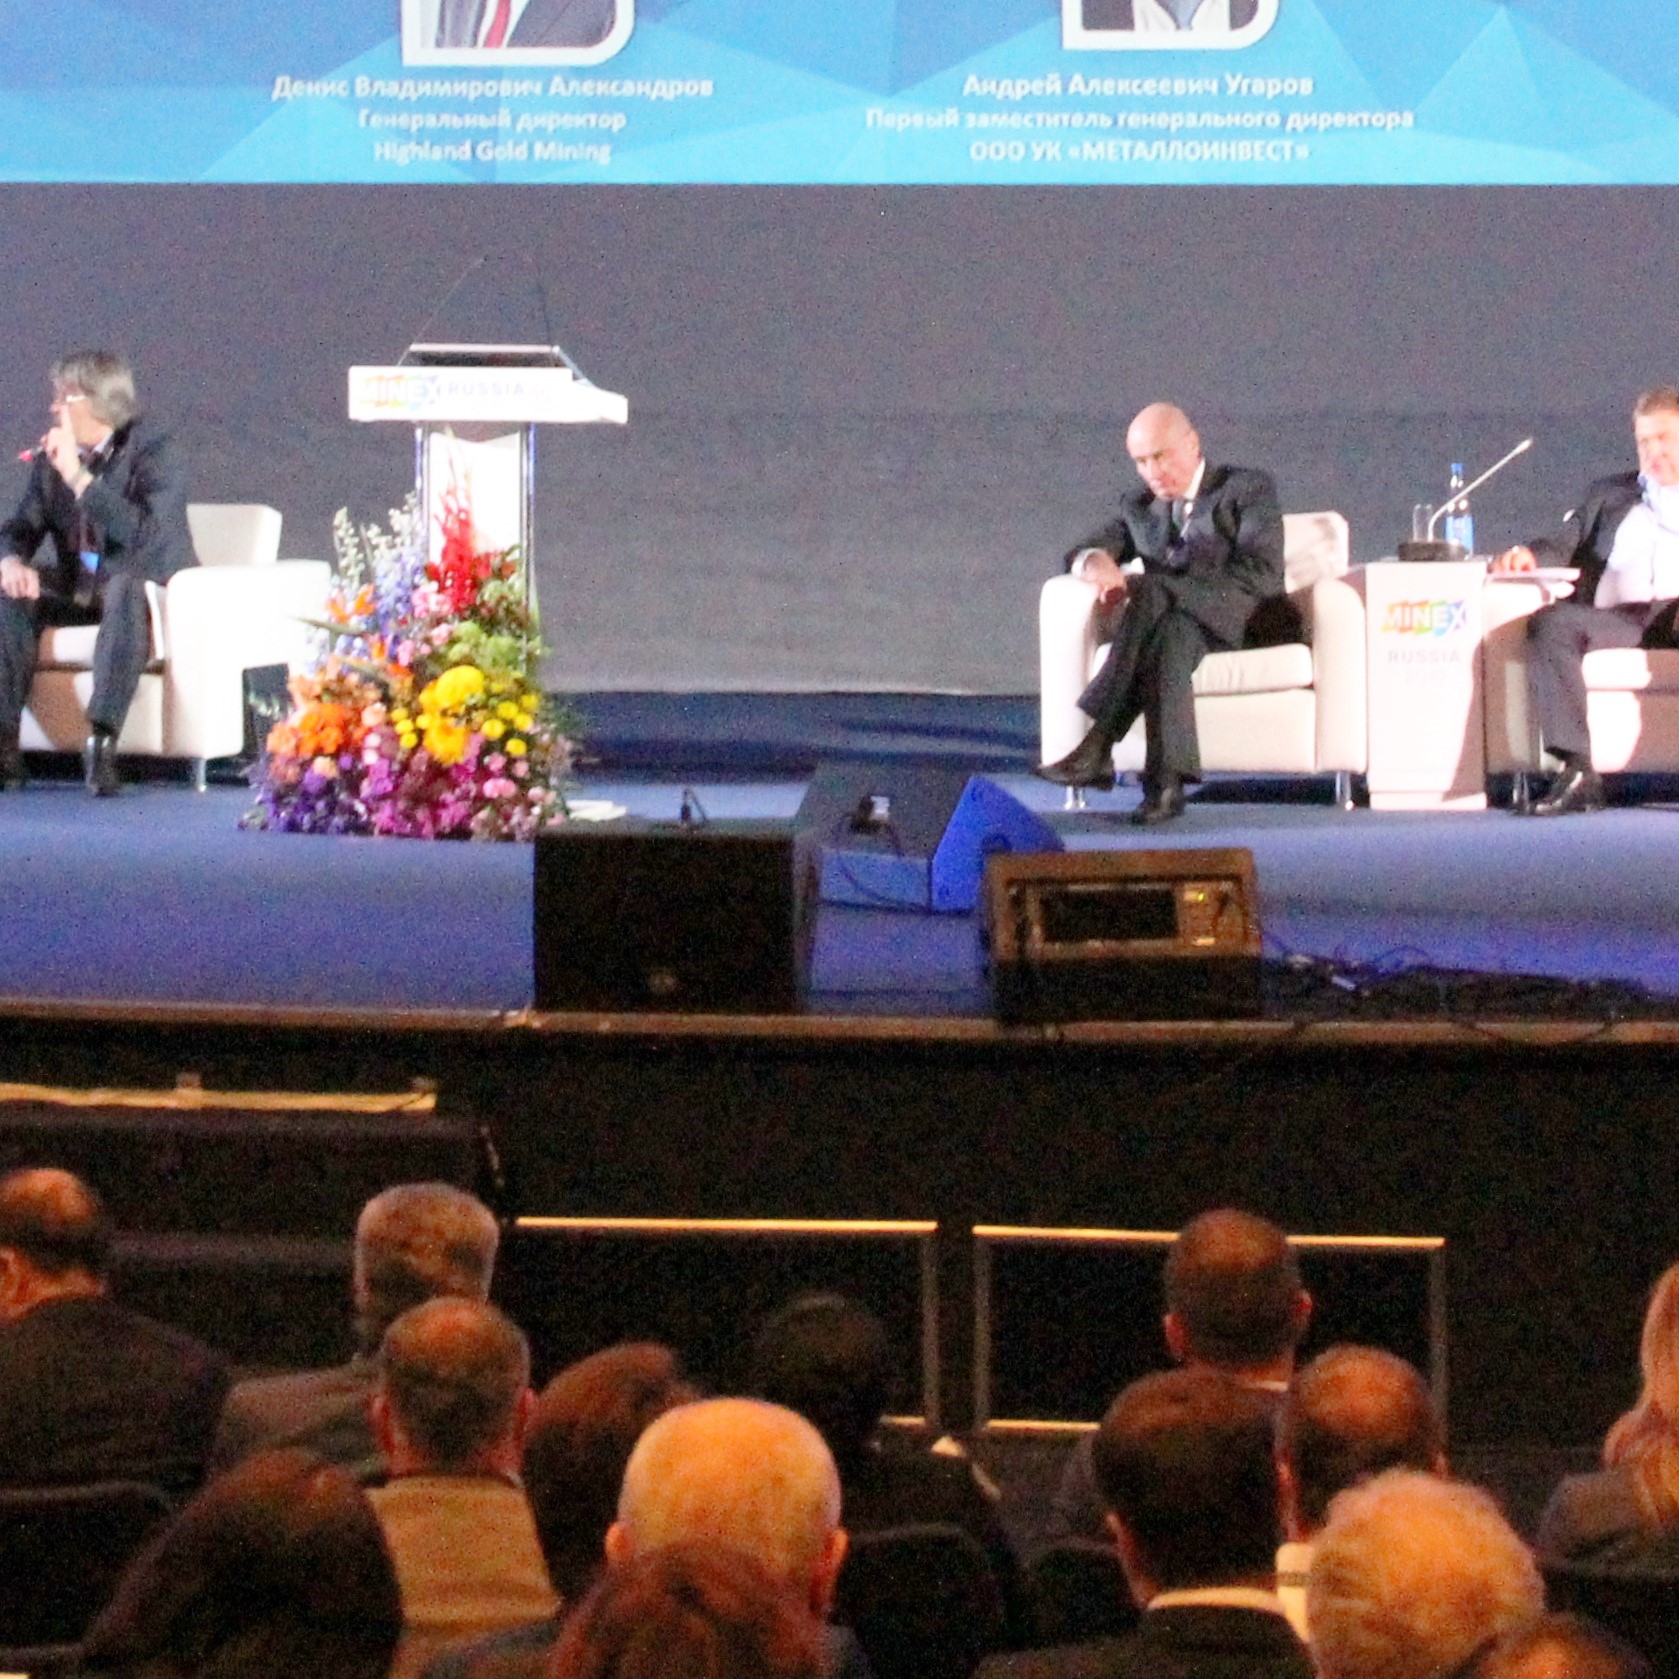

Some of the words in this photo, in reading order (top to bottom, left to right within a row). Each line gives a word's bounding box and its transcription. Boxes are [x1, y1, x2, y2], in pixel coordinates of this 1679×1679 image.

[272, 76, 348, 100] Денис
[354, 76, 542, 101] Владимирович
[548, 76, 714, 100] Александров
[963, 74, 1061, 98] Андрей
[1069, 73, 1218, 97] Алексеевич
[1225, 73, 1313, 98] Угаров
[358, 108, 511, 130] Генеральный
[516, 110, 626, 132] директор
[866, 108, 958, 131] Первый
[966, 110, 1111, 130] заместитель
[1118, 110, 1280, 131] генерального
[1285, 109, 1414, 132] директора
[375, 141, 472, 166] Highland
[476, 141, 528, 162] Gold
[534, 140, 612, 165] Mining
[970, 140, 1021, 162] ООО
[1031, 140, 1063, 162] УК
[1380, 599, 1468, 637] MINEX
[1388, 648, 1461, 665] RUSSIA
